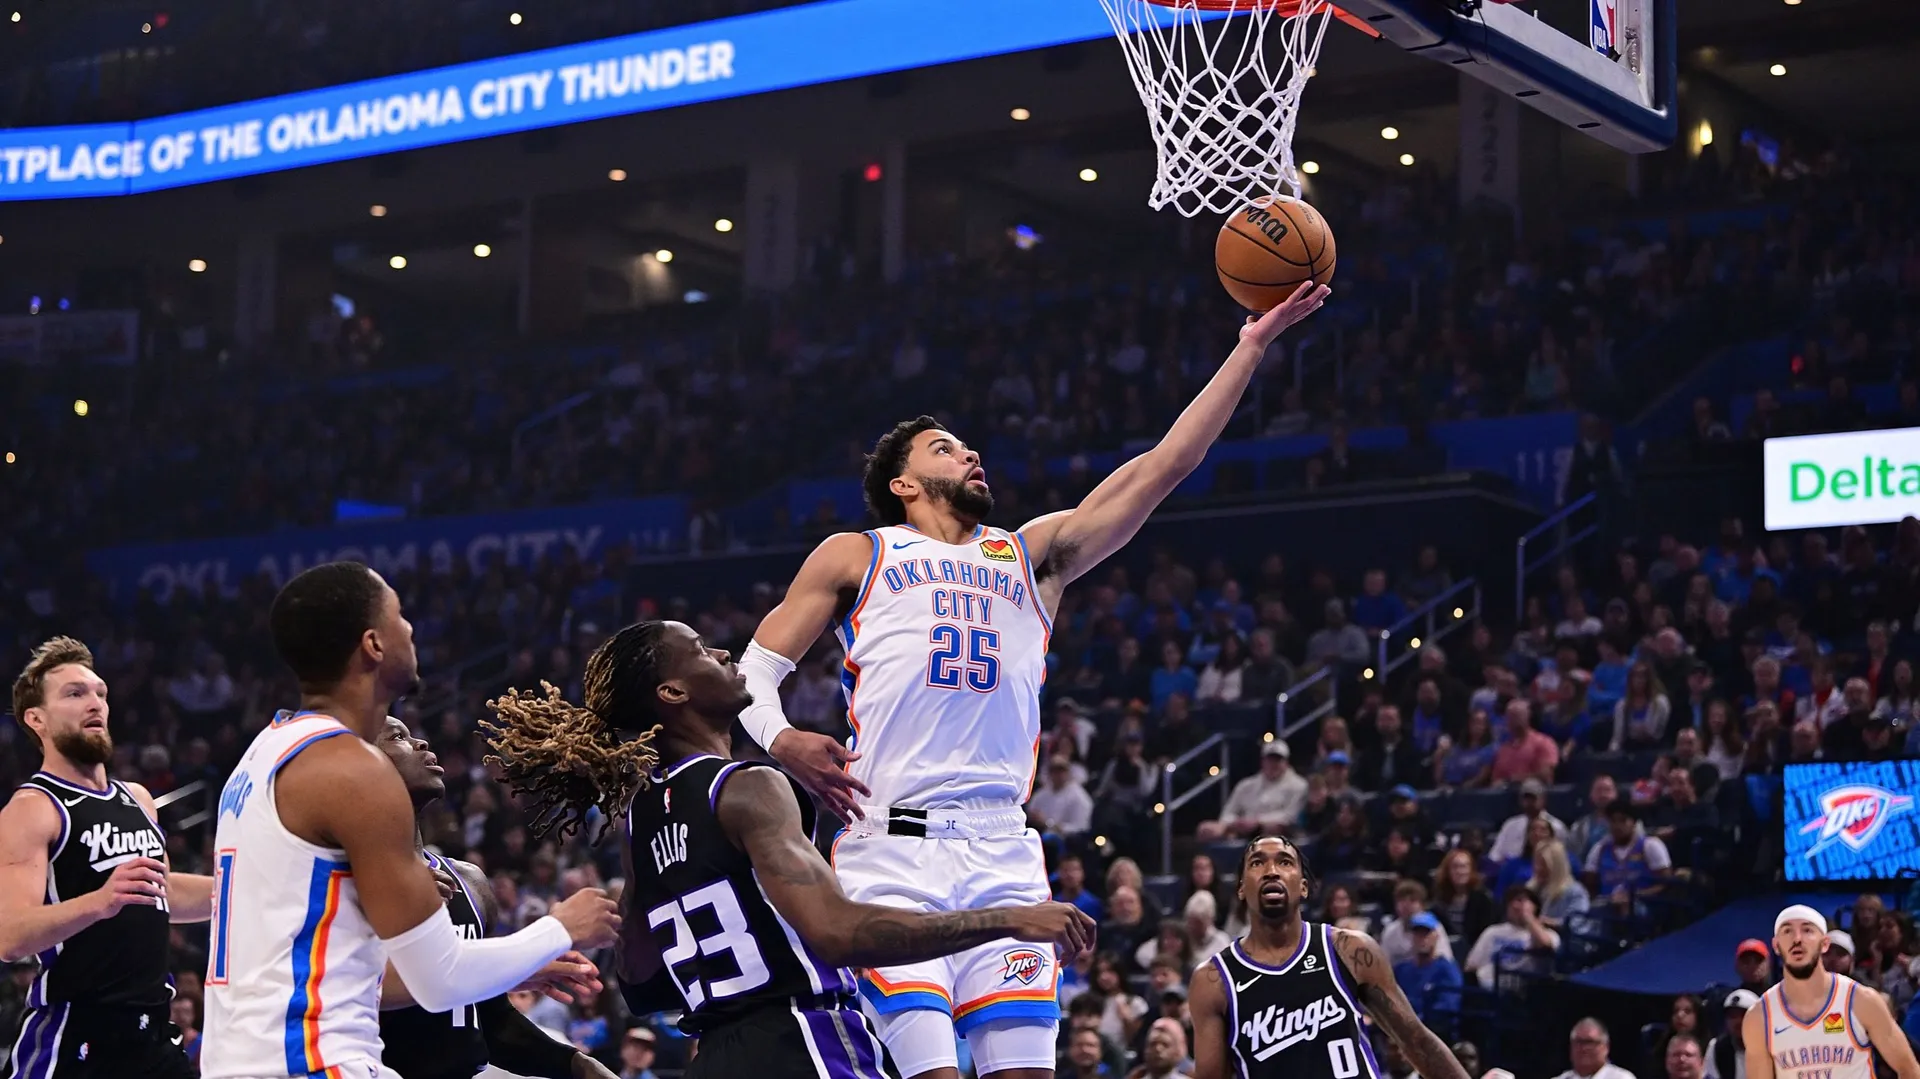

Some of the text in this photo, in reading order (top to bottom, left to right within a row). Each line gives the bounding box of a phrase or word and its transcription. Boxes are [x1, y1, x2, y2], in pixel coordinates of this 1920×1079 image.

[0, 42, 735, 183] TPLACE OF THE OKLAHOMA CITY THUNDER
[1790, 456, 1920, 502] Delta
[882, 558, 1026, 610] OKLAHOMA
[932, 588, 992, 625] CITY
[926, 622, 1001, 693] 25
[1820, 797, 1876, 838] OKC
[80, 822, 164, 872] Kings
[650, 822, 689, 875] ELLIS
[205, 848, 236, 986] 1
[647, 879, 771, 1012] 23
[1004, 956, 1038, 980] OKC
[1241, 995, 1346, 1062] Kings
[1326, 1037, 1360, 1079] 0
